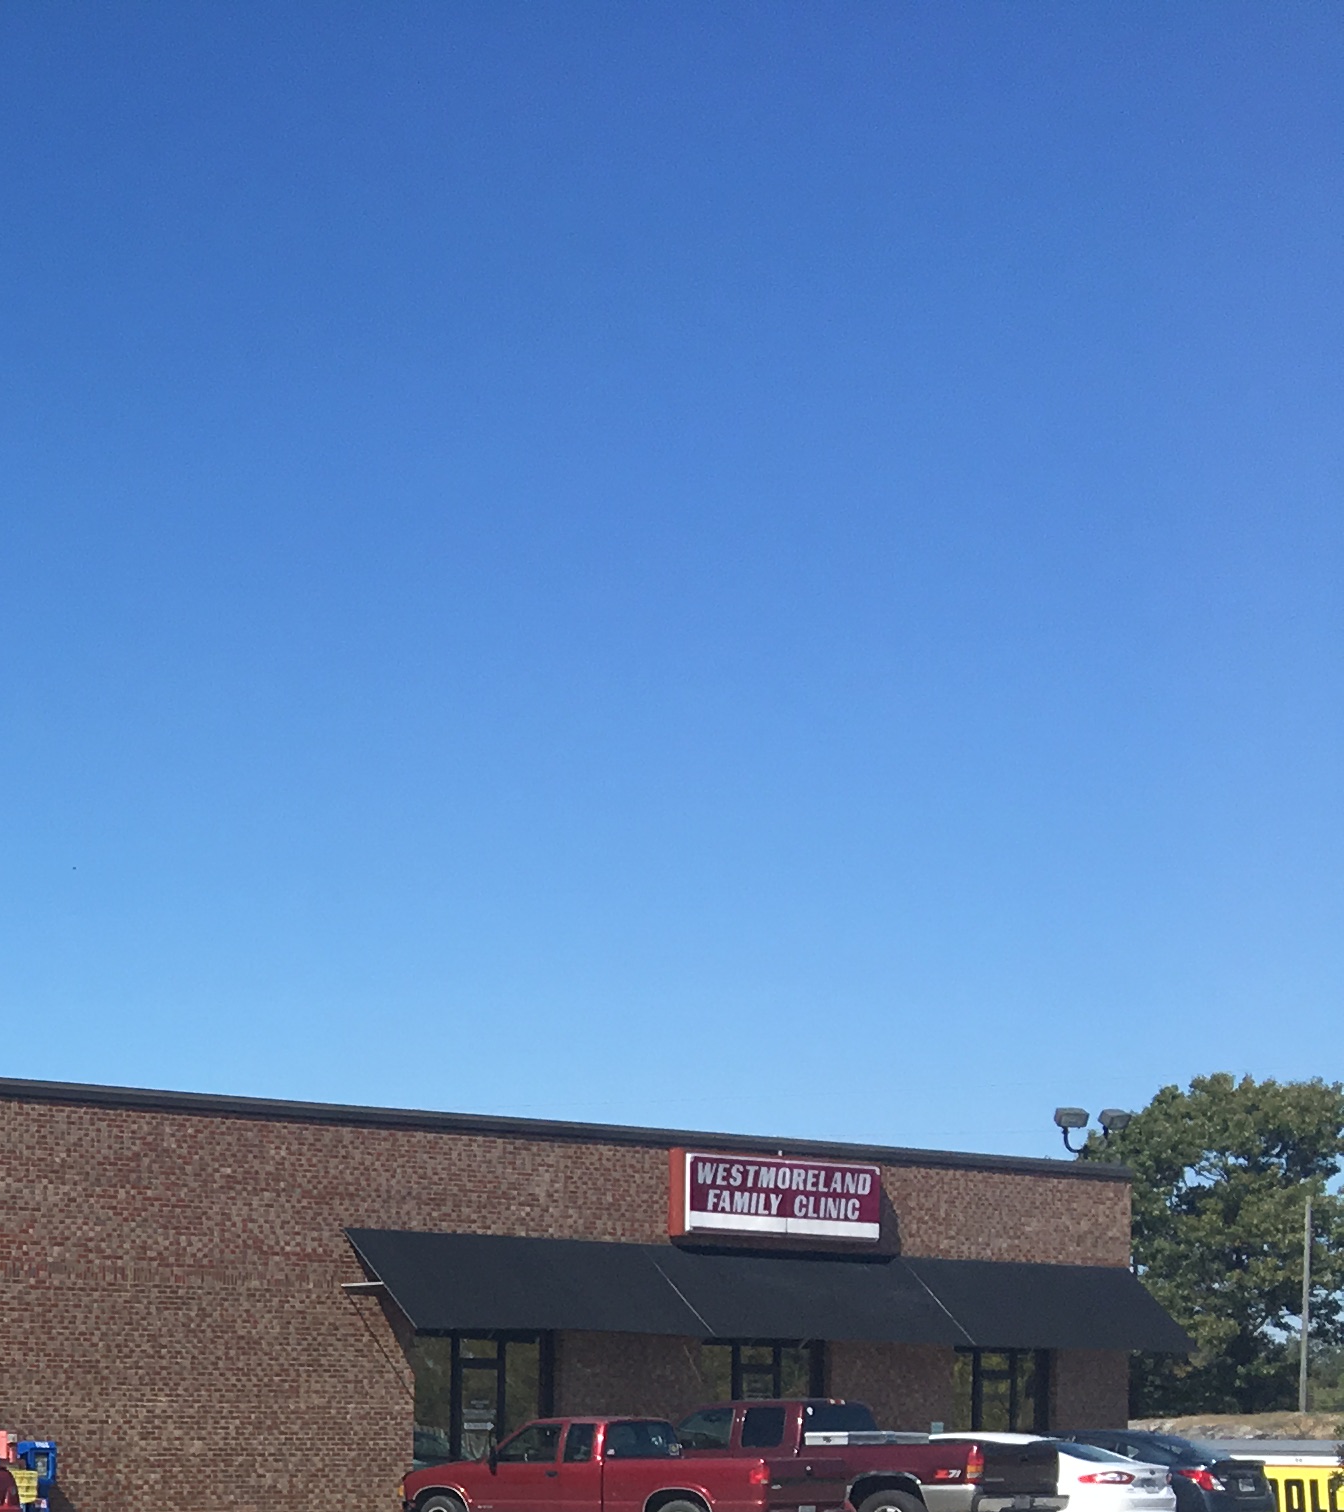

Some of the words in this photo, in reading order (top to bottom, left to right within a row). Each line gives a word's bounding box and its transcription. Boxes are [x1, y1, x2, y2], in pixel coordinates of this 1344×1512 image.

[696, 1161, 872, 1196] WESTMORELAND
[706, 1189, 782, 1215] FAMILY
[793, 1194, 860, 1220] CLINIC
